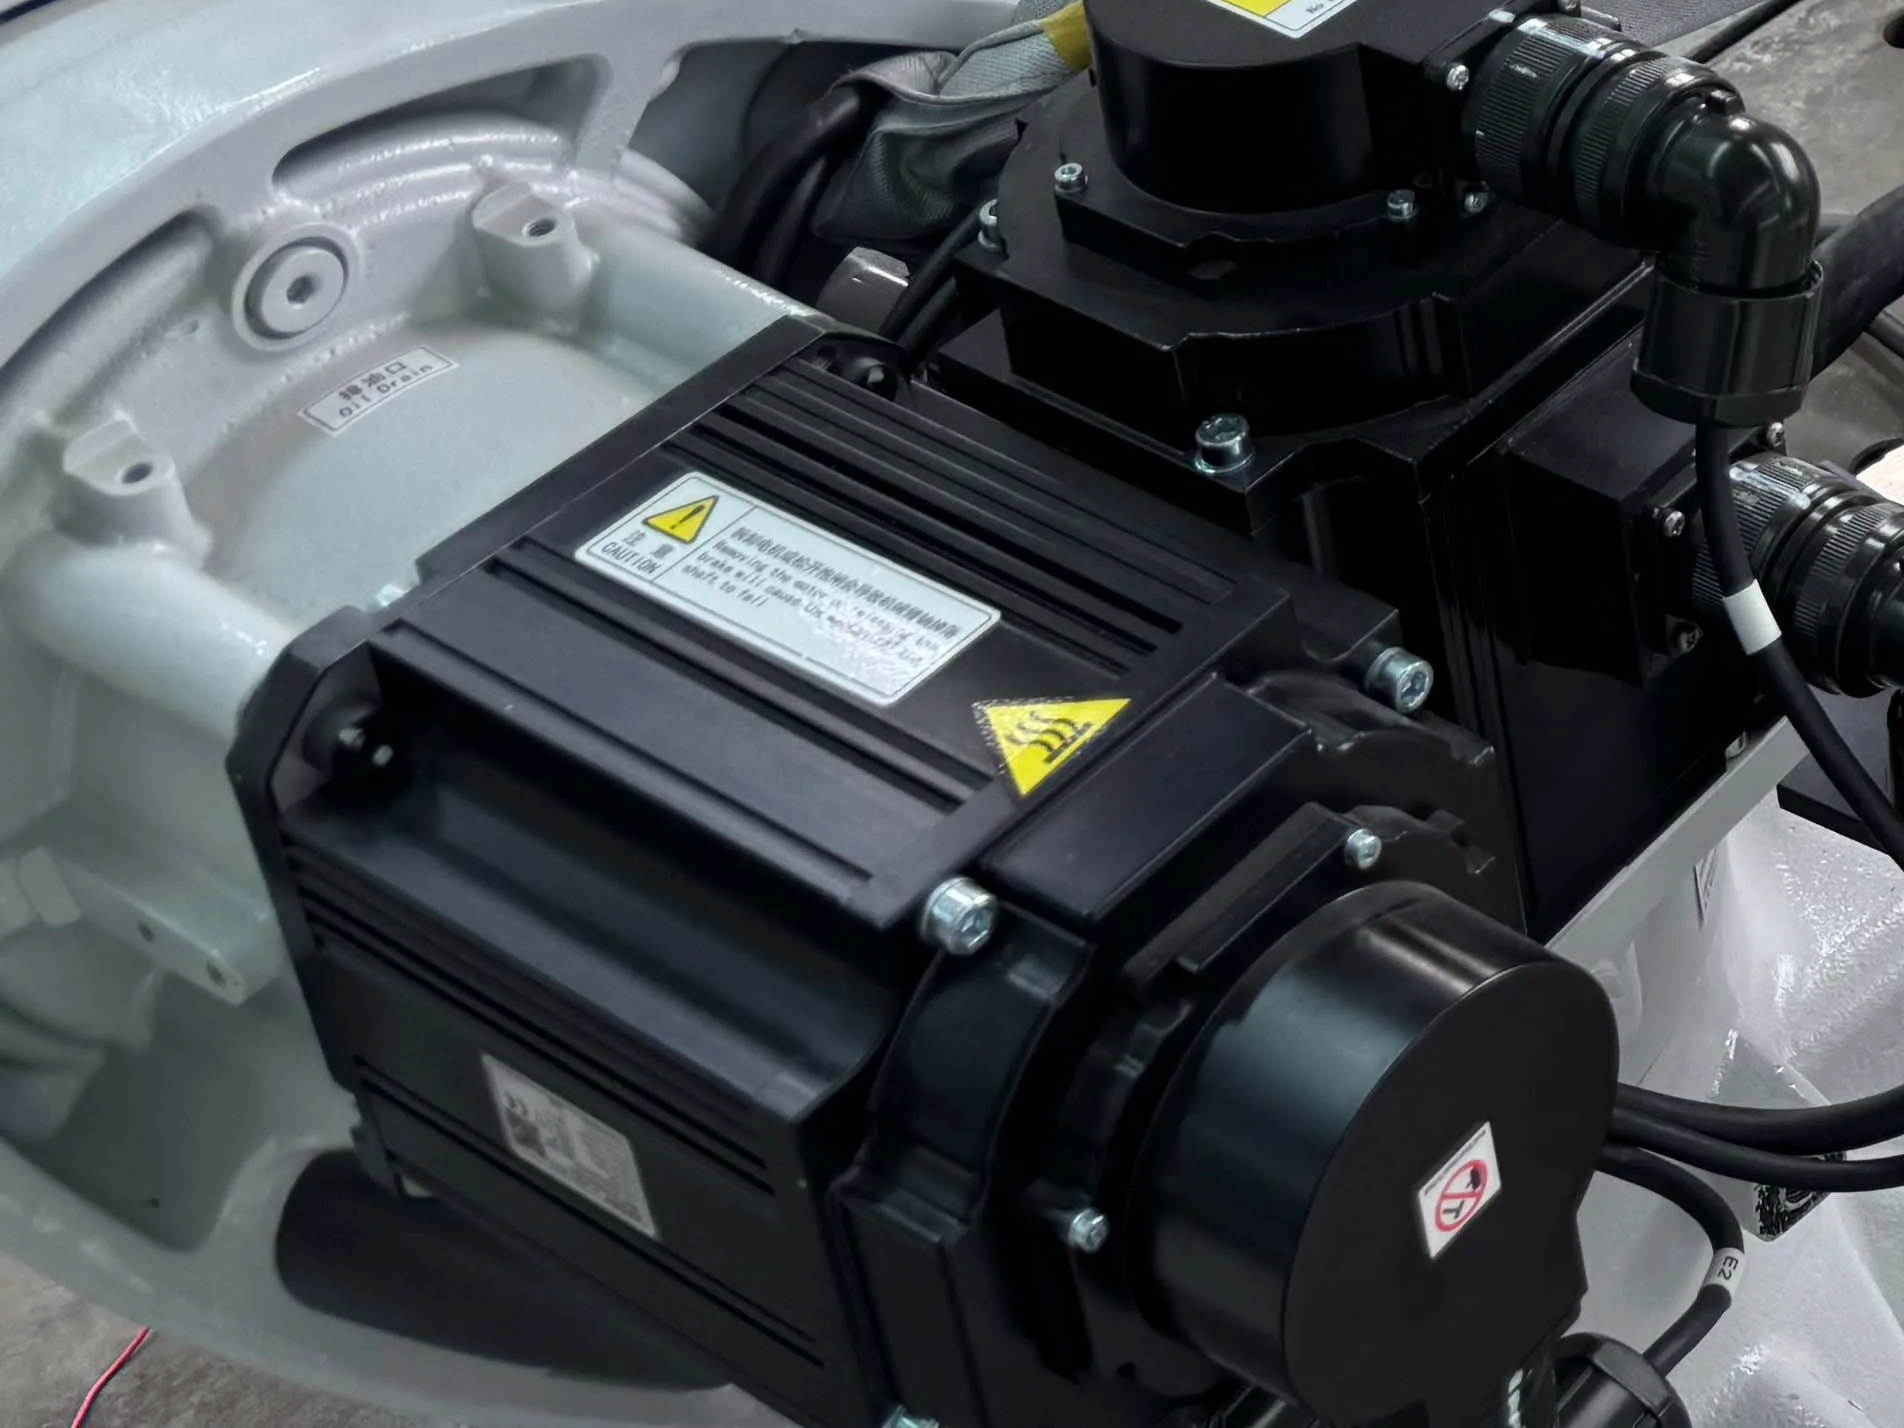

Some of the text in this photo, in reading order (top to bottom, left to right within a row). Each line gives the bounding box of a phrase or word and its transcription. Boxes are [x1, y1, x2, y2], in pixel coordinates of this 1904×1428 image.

[1306, 2, 1324, 15] No
[339, 364, 433, 418] Oil Drain
[602, 541, 661, 575] CAUTION
[697, 552, 734, 573] brake
[736, 571, 767, 588] will
[764, 585, 802, 606] cause
[713, 539, 769, 572] Removing
[770, 567, 792, 583] the
[682, 564, 770, 608] shaft to fall
